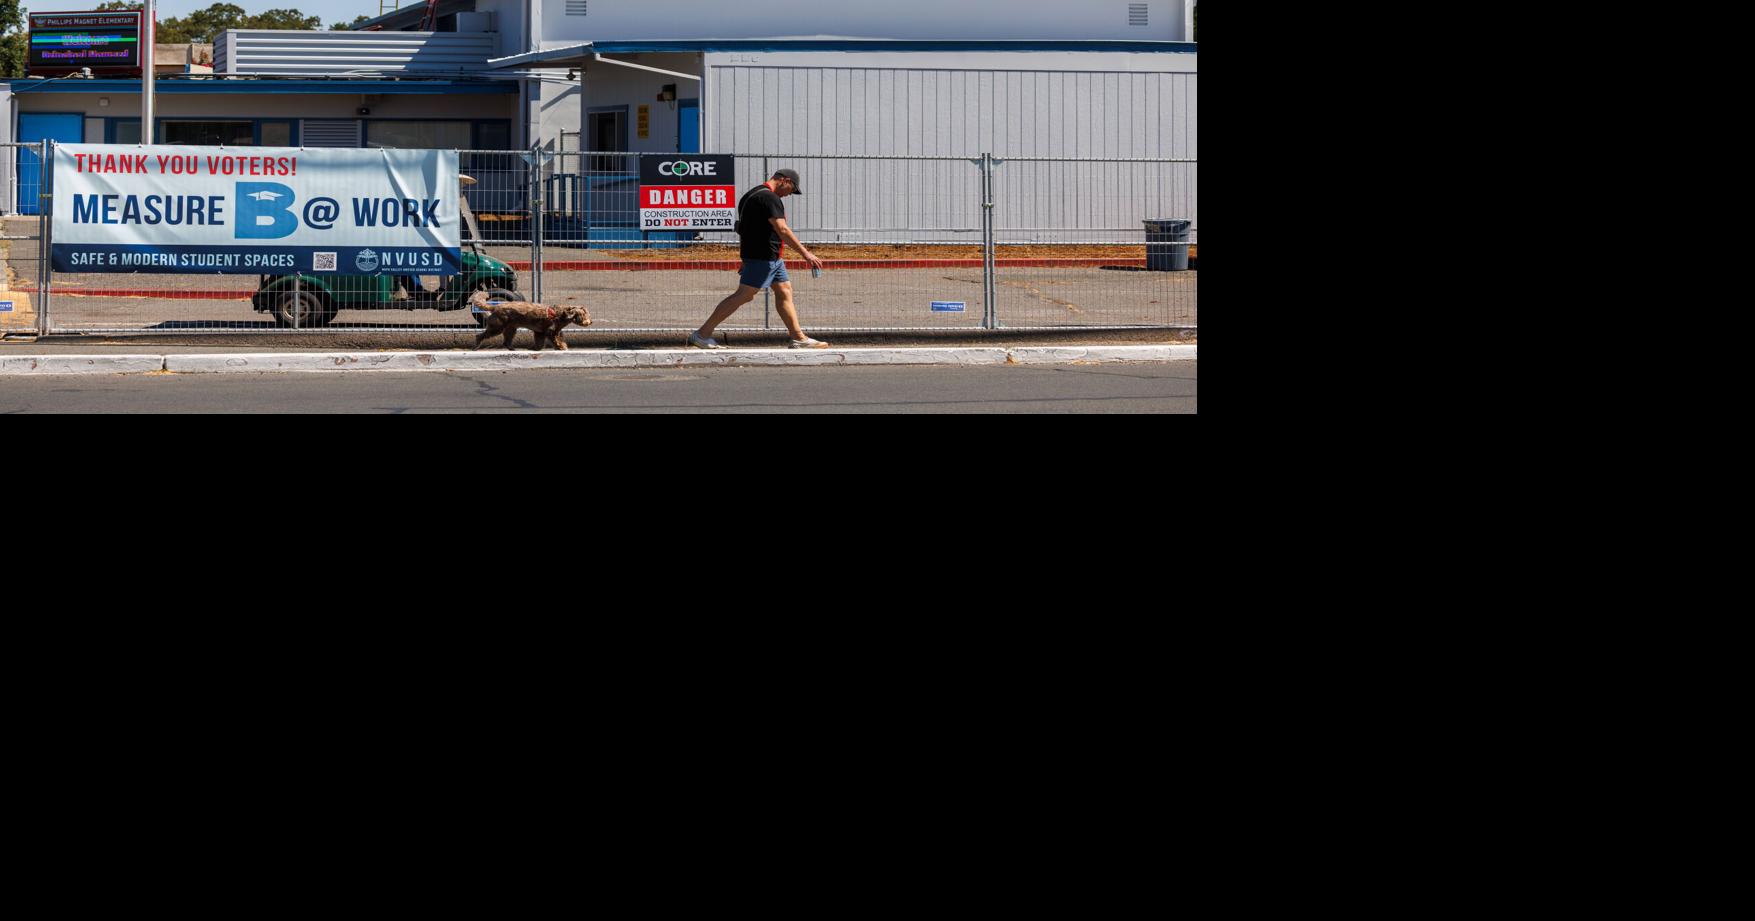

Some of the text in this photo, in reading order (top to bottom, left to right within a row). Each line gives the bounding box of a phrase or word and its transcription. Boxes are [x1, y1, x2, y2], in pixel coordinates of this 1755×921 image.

[74, 153, 297, 176] THANK YOU VOTERS!
[658, 160, 717, 177] CORE
[649, 189, 727, 205] DANGER
[73, 181, 441, 240] MEASURE B @ WORK
[644, 210, 733, 218] CONSTRUCTION AREA
[645, 218, 732, 227] DO NOT ENTER
[71, 252, 295, 267] SAFE & MODERN STUDENT SPACES
[381, 252, 443, 266] NVUSD
